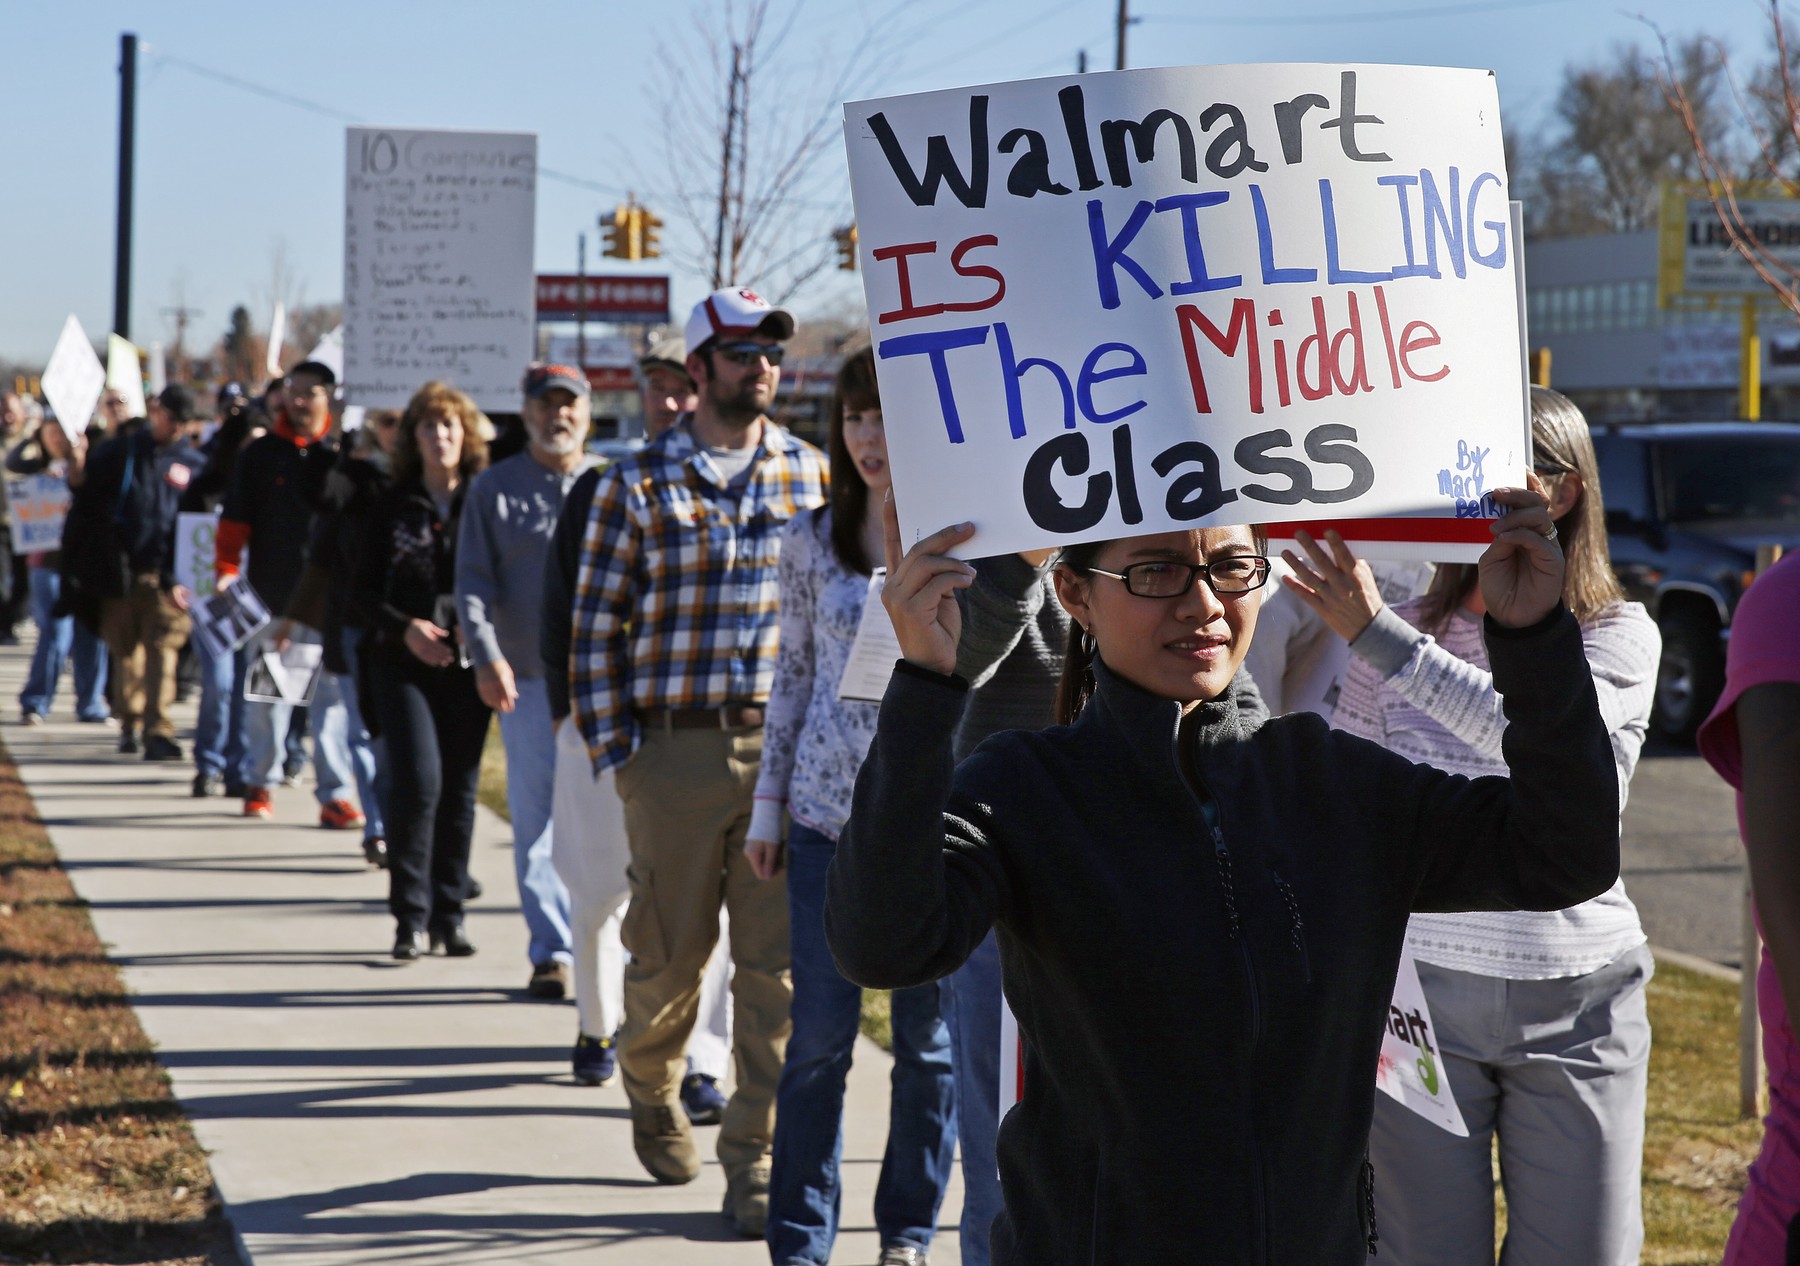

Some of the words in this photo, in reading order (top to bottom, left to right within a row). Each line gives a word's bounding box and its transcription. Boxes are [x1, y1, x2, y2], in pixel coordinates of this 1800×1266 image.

[361, 132, 398, 175] 10
[867, 71, 1392, 208] Walmart
[873, 234, 1007, 324] IS
[1087, 166, 1506, 309] KILLING
[879, 322, 1148, 443] The
[1176, 285, 1449, 414] Middle
[1023, 423, 1375, 533] Class
[1456, 439, 1490, 480] By
